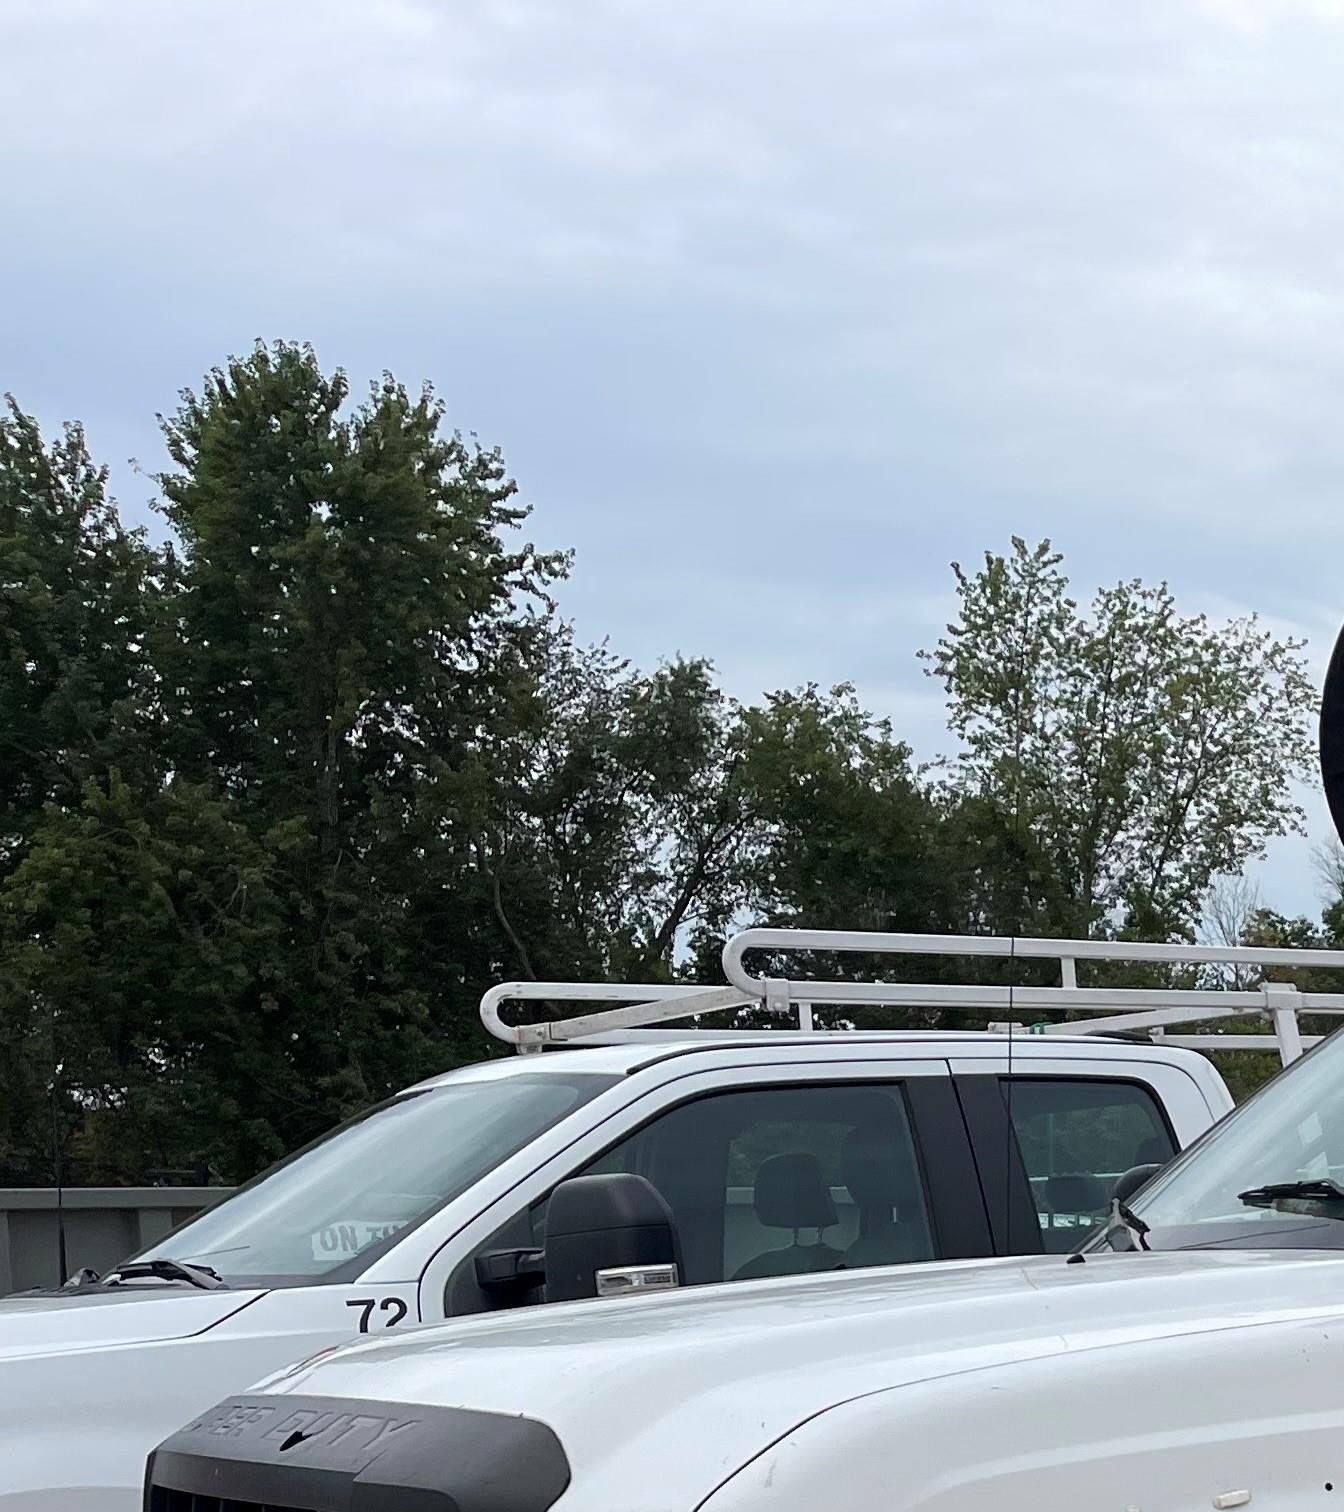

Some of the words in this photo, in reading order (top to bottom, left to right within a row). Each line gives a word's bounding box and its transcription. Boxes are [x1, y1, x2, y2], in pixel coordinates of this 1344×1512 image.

[320, 1225, 358, 1252] ON
[345, 1297, 408, 1334] 72
[260, 1408, 422, 1451] DUTY
